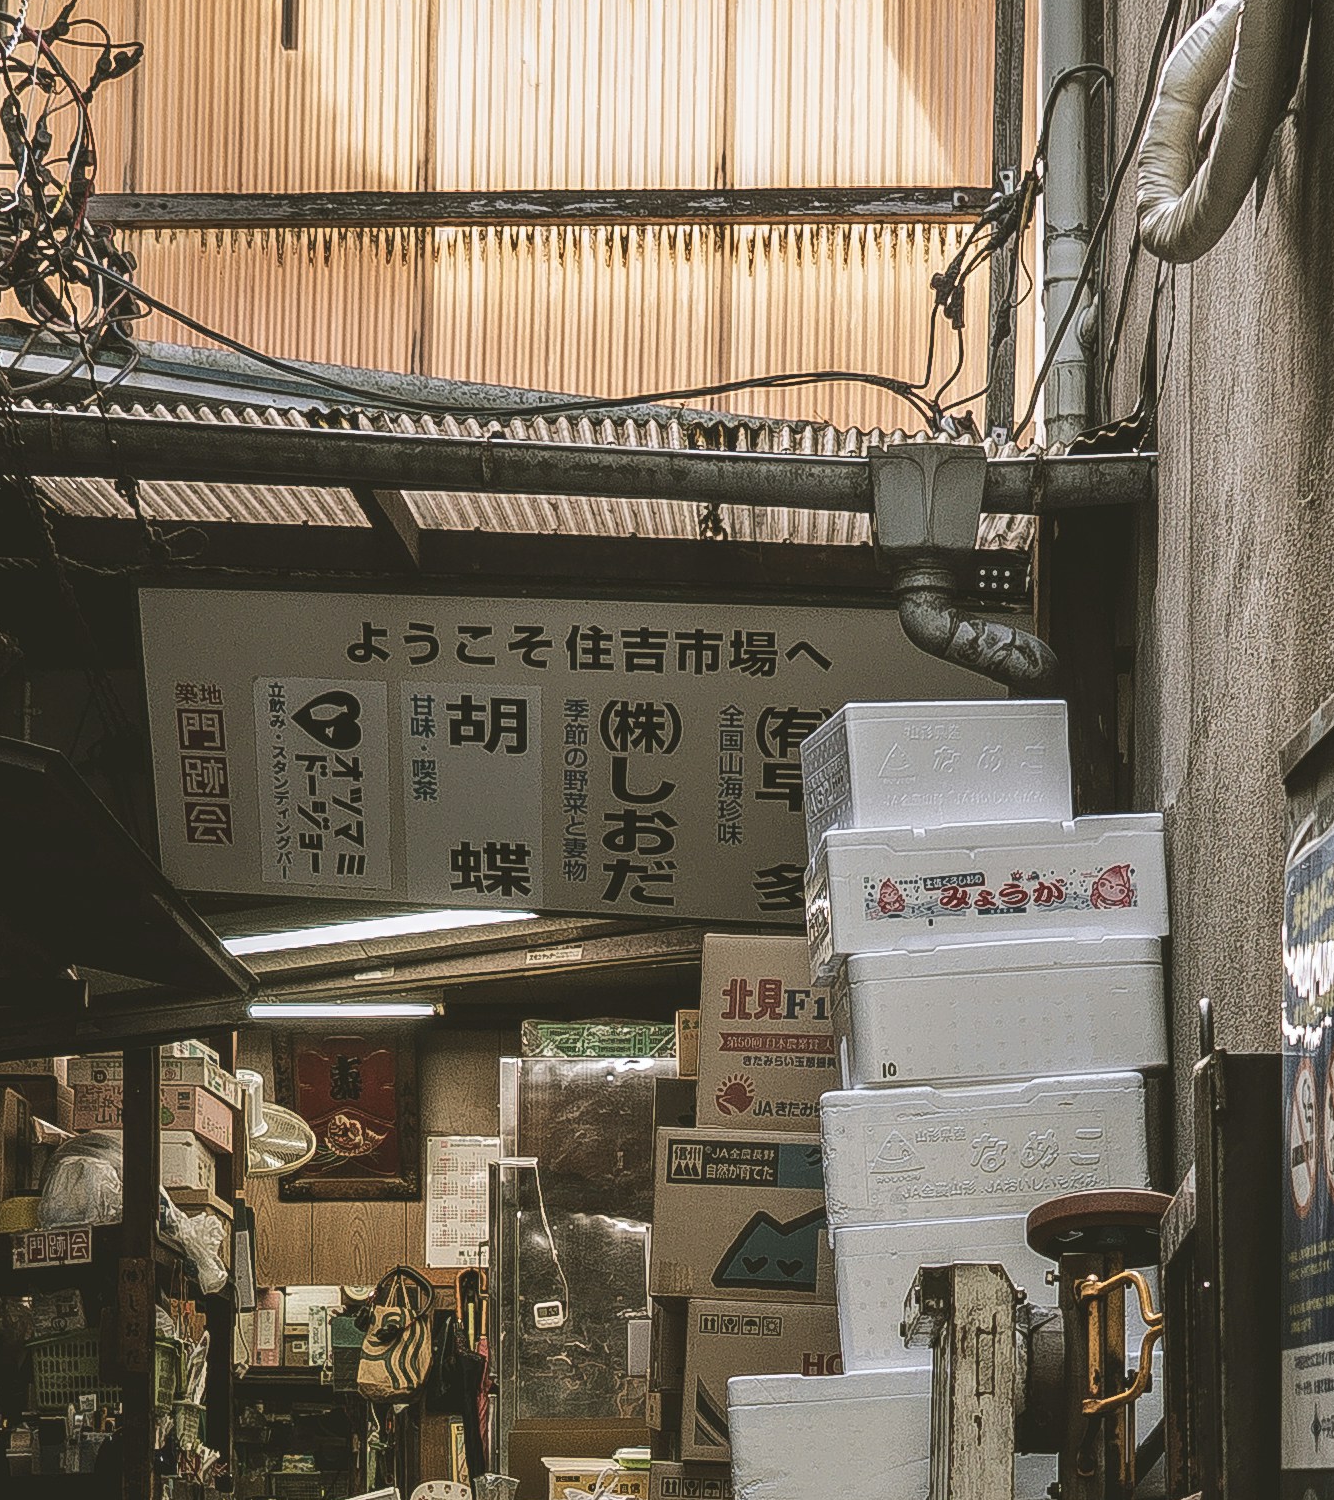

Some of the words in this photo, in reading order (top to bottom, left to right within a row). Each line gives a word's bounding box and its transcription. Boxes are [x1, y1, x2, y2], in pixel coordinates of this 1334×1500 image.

[175, 682, 223, 705] 築地
[346, 620, 833, 678] ようこそ住吉市場へ
[177, 708, 233, 845] 門跡会
[410, 695, 438, 802] 甘味・喫茶
[563, 699, 589, 883] 季節の野菜と妻物
[718, 704, 744, 846] 全国山海珍味
[295, 753, 329, 875] ドージョー
[331, 753, 366, 877] オツマミ
[940, 879, 1067, 910] みょうが
[706, 1163, 774, 1181] 自然が育てた
[28, 1230, 90, 1263] 門跡会
